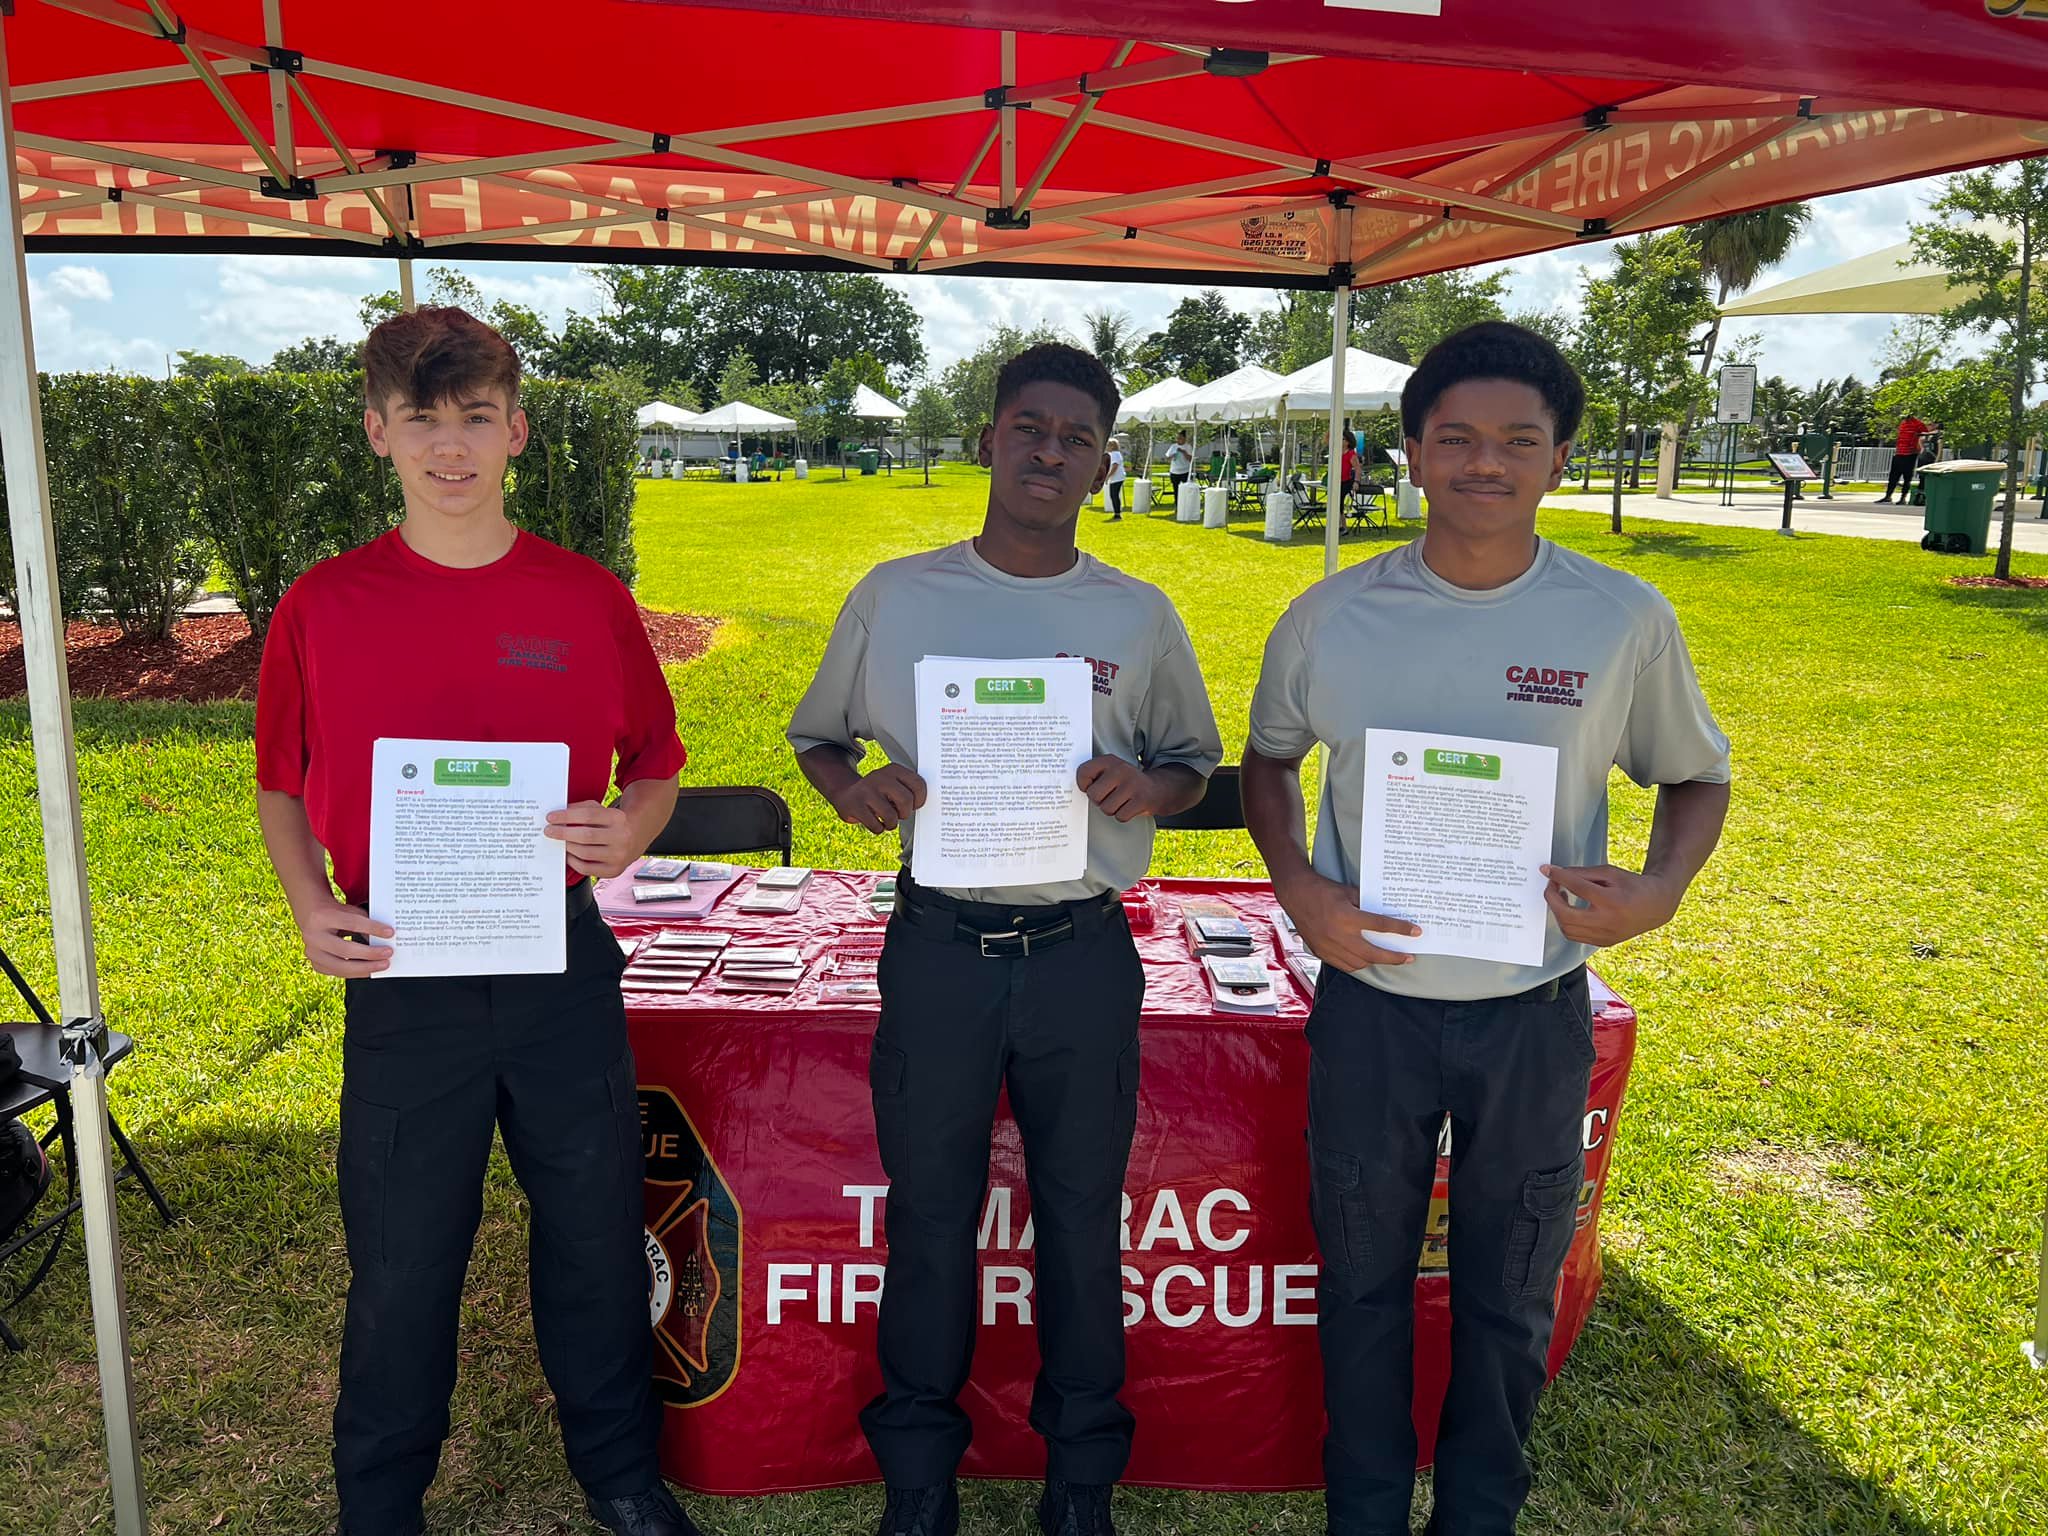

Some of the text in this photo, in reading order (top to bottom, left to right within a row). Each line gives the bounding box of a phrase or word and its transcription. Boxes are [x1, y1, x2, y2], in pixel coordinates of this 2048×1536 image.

[496, 632, 574, 656] CADET
[509, 648, 559, 663] TAMARAC
[498, 656, 568, 673] FIRE RESCUE
[1055, 652, 1119, 680] DET
[1506, 665, 1589, 689] CADET
[987, 679, 1016, 691] CERT
[1518, 684, 1576, 697] TAMARAC
[1506, 692, 1583, 707] FIRE RESCUE
[1437, 751, 1469, 765] CERT
[447, 760, 480, 773] CERT
[1387, 774, 1415, 782] Broward
[843, 1185, 1251, 1252] TMAC
[767, 1263, 1319, 1328] FIR RCUE
